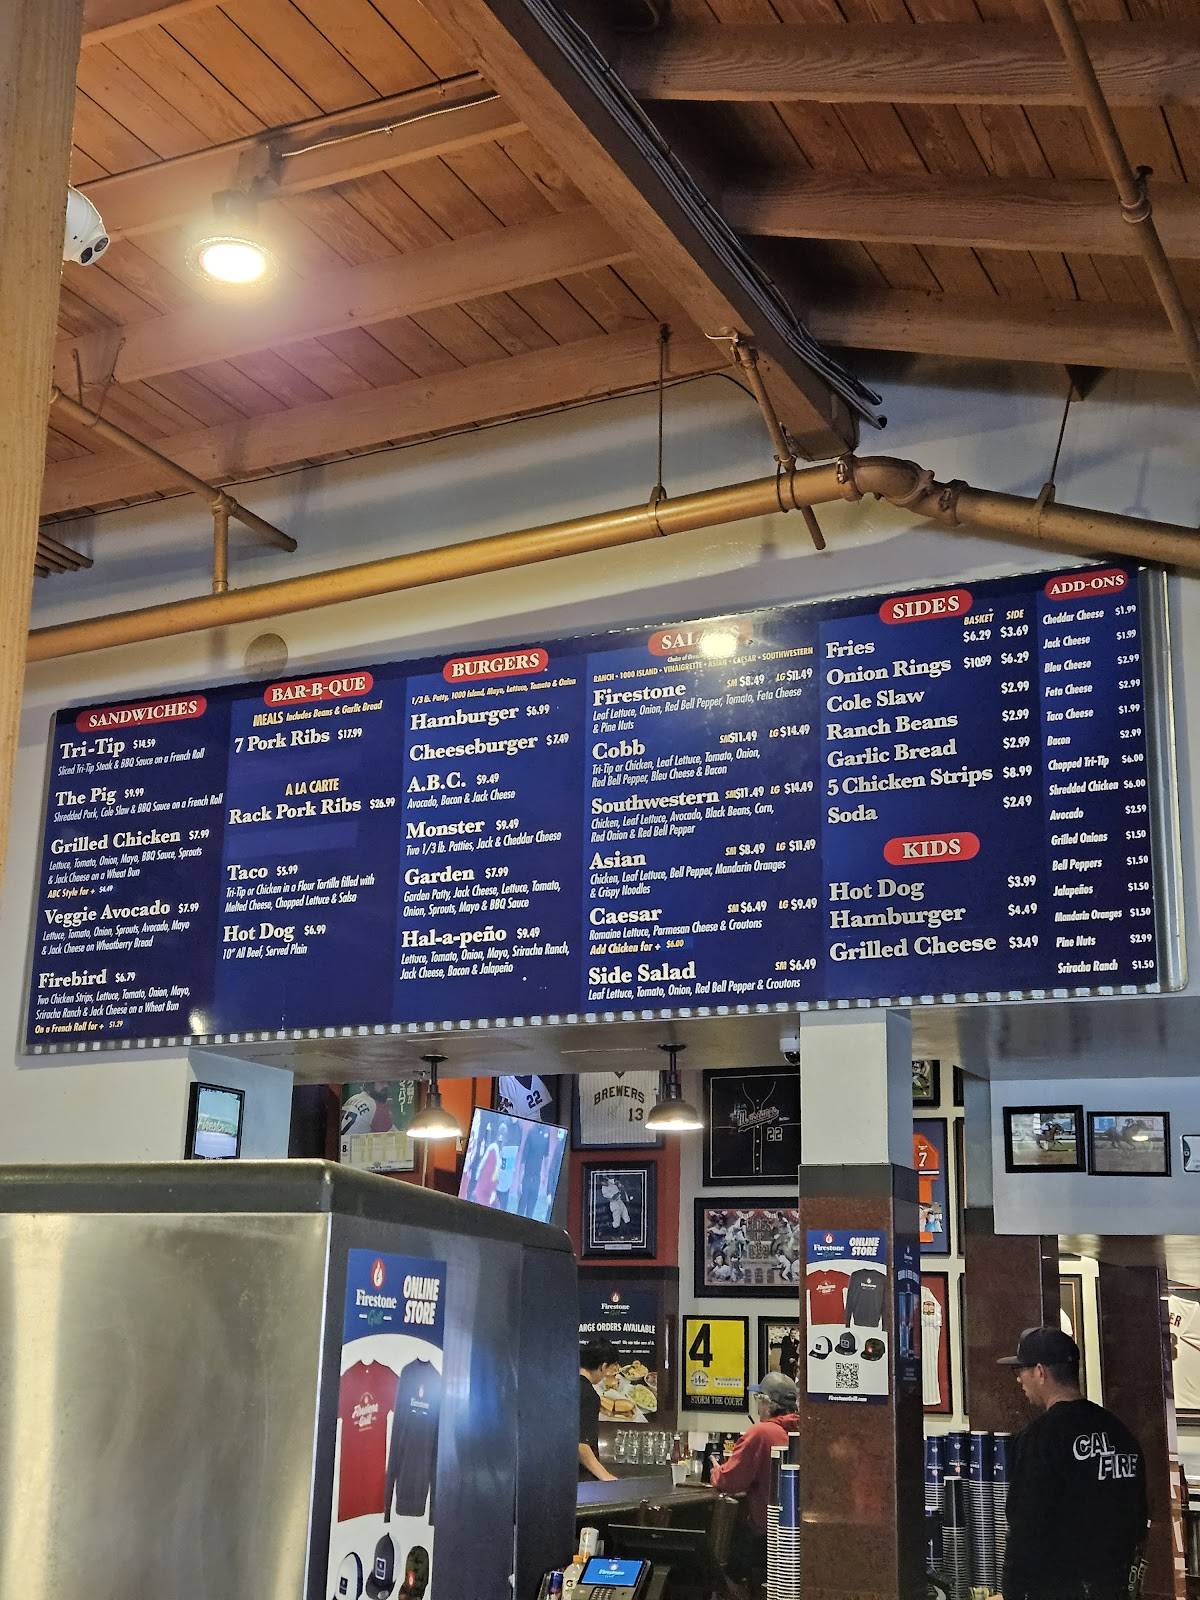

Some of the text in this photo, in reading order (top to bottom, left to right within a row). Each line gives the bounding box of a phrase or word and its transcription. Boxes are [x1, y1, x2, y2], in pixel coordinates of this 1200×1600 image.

[1050, 575, 1124, 594] ADD-ONS
[893, 596, 959, 618] SIDES
[964, 609, 1024, 625] BASKET SIDE
[1043, 605, 1136, 624] Cheddar Cheese $1.99
[826, 625, 1028, 658] Fries $6.29 $3.69
[452, 653, 539, 677] BURGERS
[827, 651, 1029, 685] Onion Rings $10.99 $6.29
[272, 676, 366, 702] BAR-B-QUE
[593, 685, 686, 706] Firestone
[740, 673, 764, 687] $8.49
[786, 668, 812, 683] $11.49
[827, 681, 1029, 712] Cole Slaw $2.99
[88, 700, 198, 728] SANDWICHES
[253, 712, 283, 726] MEALS
[410, 704, 550, 730] Hamburger $6.99
[1047, 704, 1140, 721] Taco Cheese $1.99
[826, 709, 1029, 740] Ranch Beans $2.99
[235, 728, 362, 753] 7 Pork Ribs $17.99
[410, 733, 569, 761] Cheeseburger $7.49
[1047, 728, 1141, 746] Bacon $2.99
[60, 738, 156, 759] Tri-Tip $14.59
[592, 739, 645, 759] Cobb
[828, 736, 1030, 767] Garlic Bread $2.99
[286, 778, 339, 796] A LA CARTE
[407, 772, 499, 792] A.B.C. $9.49
[827, 765, 1032, 796] 5 Chicken Strips $8.99
[56, 787, 144, 806] The Pig $9.99
[592, 790, 720, 814] Southwestern
[229, 797, 395, 824] Rack Pork Ribs $26.99
[828, 795, 1032, 823] Soda $2.49
[1050, 804, 1146, 820] Avocado $2.59
[406, 818, 519, 839] Monster $9.49
[1051, 830, 1146, 845] Grilled Onions $1.50
[51, 829, 209, 854] Grilled Chicken $7.99
[902, 839, 960, 858] KIDS
[589, 851, 646, 870] Asian
[739, 843, 765, 856] $8.49
[789, 839, 816, 852] $11.49
[227, 865, 298, 880] Taco $5.99
[405, 866, 508, 885] Garden $7.99
[829, 875, 1036, 901] Hot Dog $3.99
[1053, 882, 1149, 898] Jalapeños $1.50
[45, 900, 199, 927] Veggie Avocado $7.99
[590, 908, 662, 925] Caesar
[740, 900, 767, 913] $6.49
[791, 898, 817, 910] $9.49
[830, 903, 1037, 928] Hamburger $4.49
[223, 923, 326, 942] Hot Dog $6.99
[402, 926, 540, 948] Hal-a-peño $9.49
[236, 947, 246, 958] All
[246, 945, 263, 958] Beef,
[266, 944, 290, 956] Served
[290, 943, 307, 954] Plain
[830, 935, 1038, 961] Grilled Cheese $3.49
[38, 969, 135, 988] Firebird $6.79
[400, 962, 513, 980] Jack Cheese, Bacon & Jalapeño
[589, 966, 632, 984] Side
[638, 961, 696, 982] Salad
[790, 958, 816, 971] $6.49
[526, 1090, 543, 1109] 22
[594, 1086, 645, 1105] BREWERS
[628, 1108, 644, 1122] 13
[767, 1127, 783, 1142] 22
[918, 1152, 928, 1166] 7
[849, 1237, 880, 1246] ONLINE
[851, 1246, 877, 1256] STORE
[356, 1275, 440, 1309] Firestone ONLINE
[404, 1300, 436, 1325] STORE
[1169, 1313, 1182, 1327] ER
[578, 1323, 656, 1334] ARGE ORDERS AVAILABLE
[689, 1324, 713, 1368] 4
[1073, 1432, 1115, 1460] CAL
[1098, 1454, 1138, 1480] FIRE
